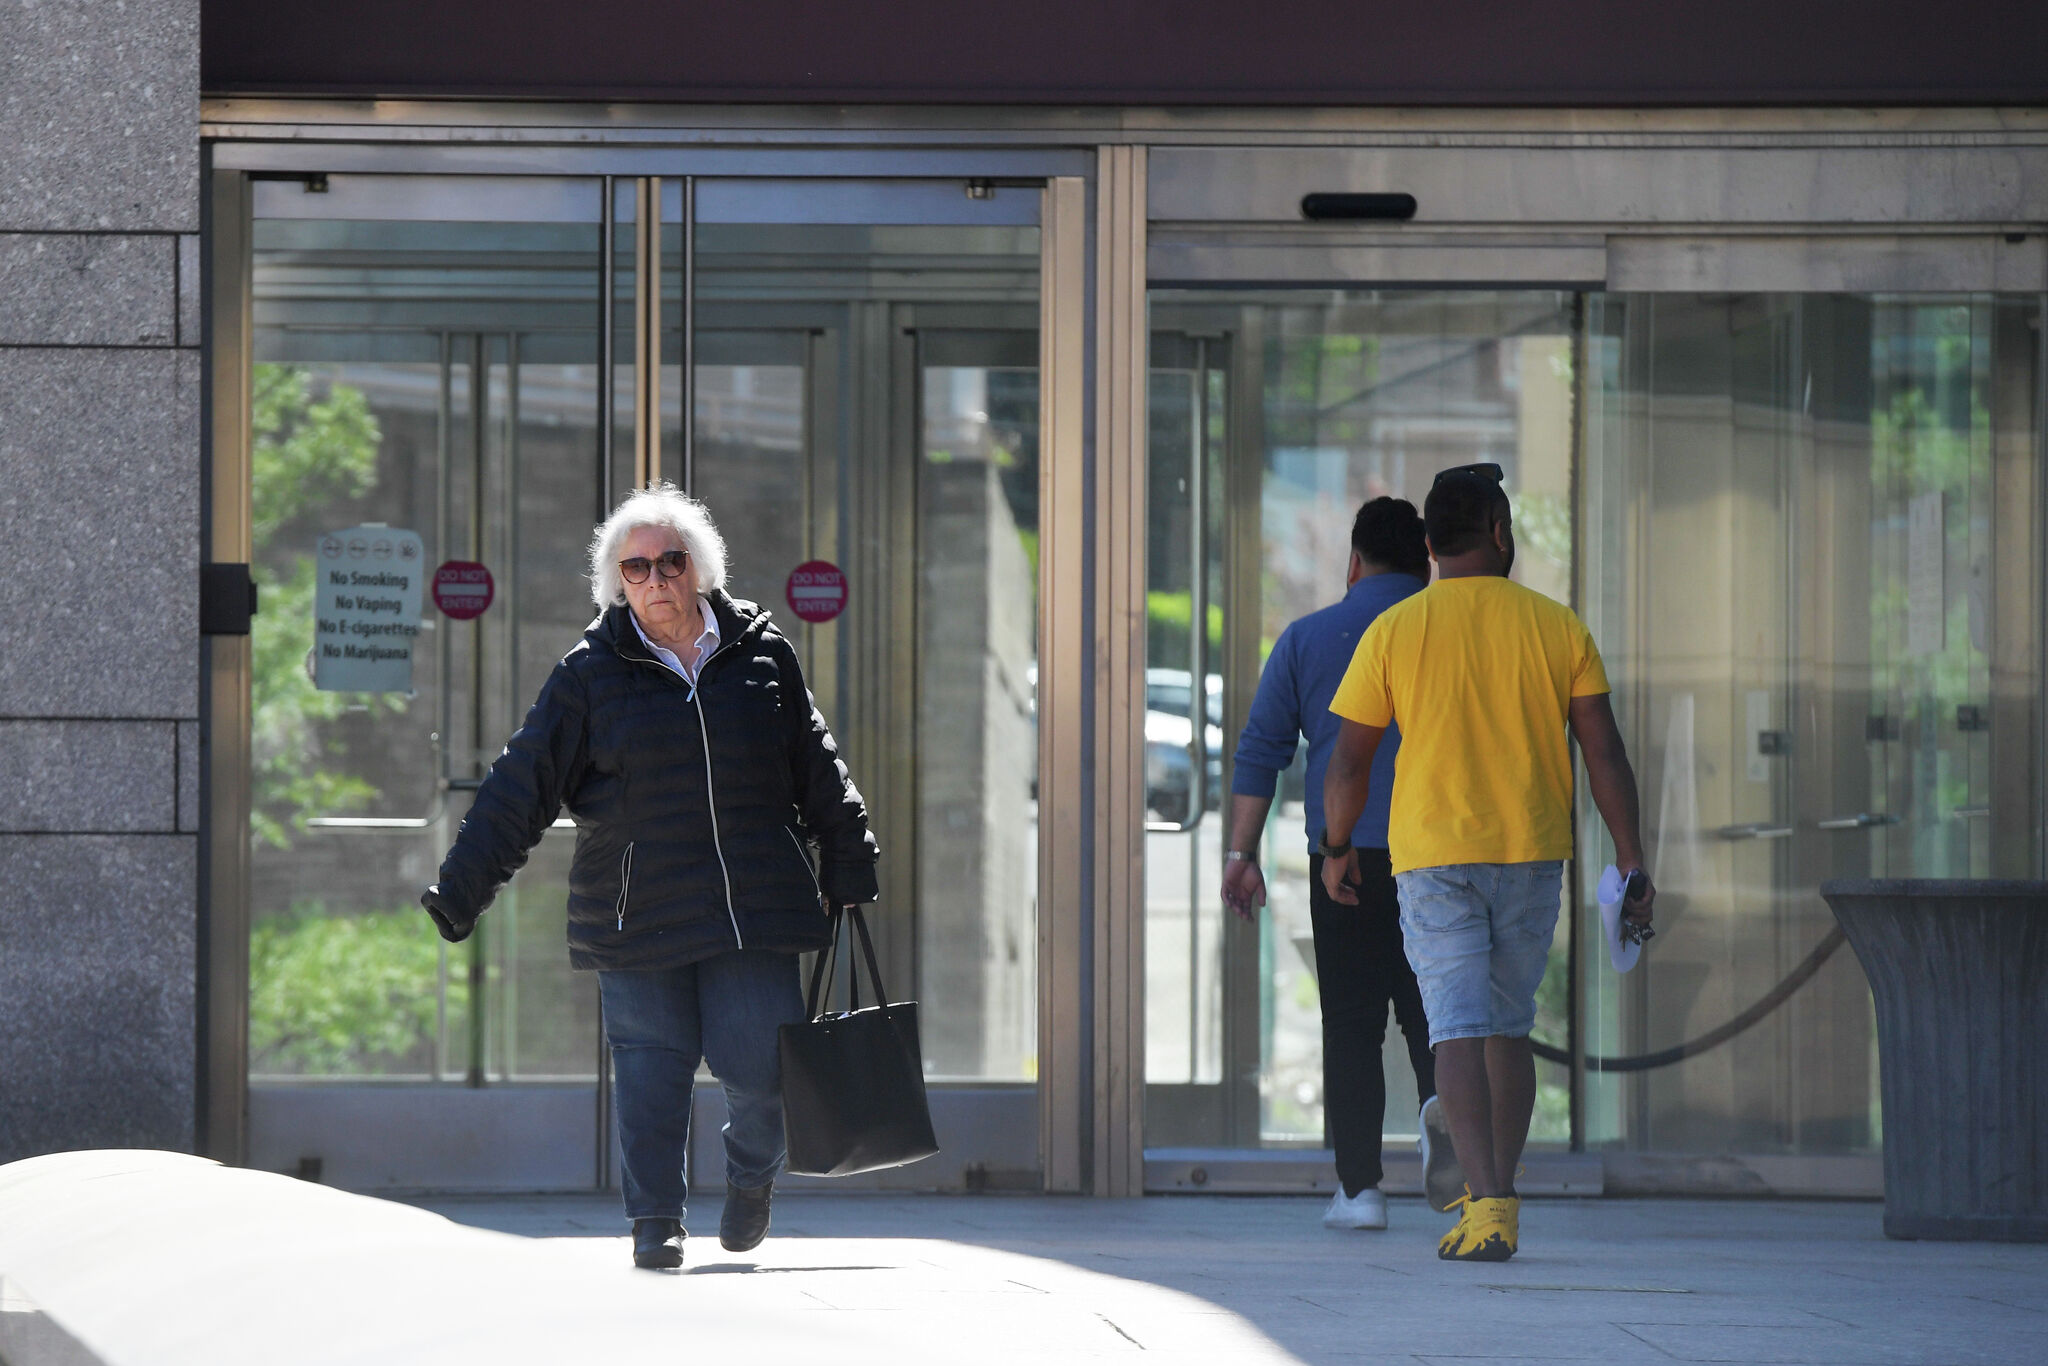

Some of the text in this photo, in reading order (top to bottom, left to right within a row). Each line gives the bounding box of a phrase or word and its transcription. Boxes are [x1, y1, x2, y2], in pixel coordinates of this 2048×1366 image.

[330, 571, 408, 590] No Smoking
[438, 570, 486, 581] DO NOT
[793, 572, 840, 584] DO NOT
[336, 595, 402, 614] No Vaping
[442, 597, 484, 609] ENTER
[796, 600, 839, 612] ENTER
[319, 619, 418, 638] No E-cigarettes
[323, 643, 408, 662] No Marijuana
